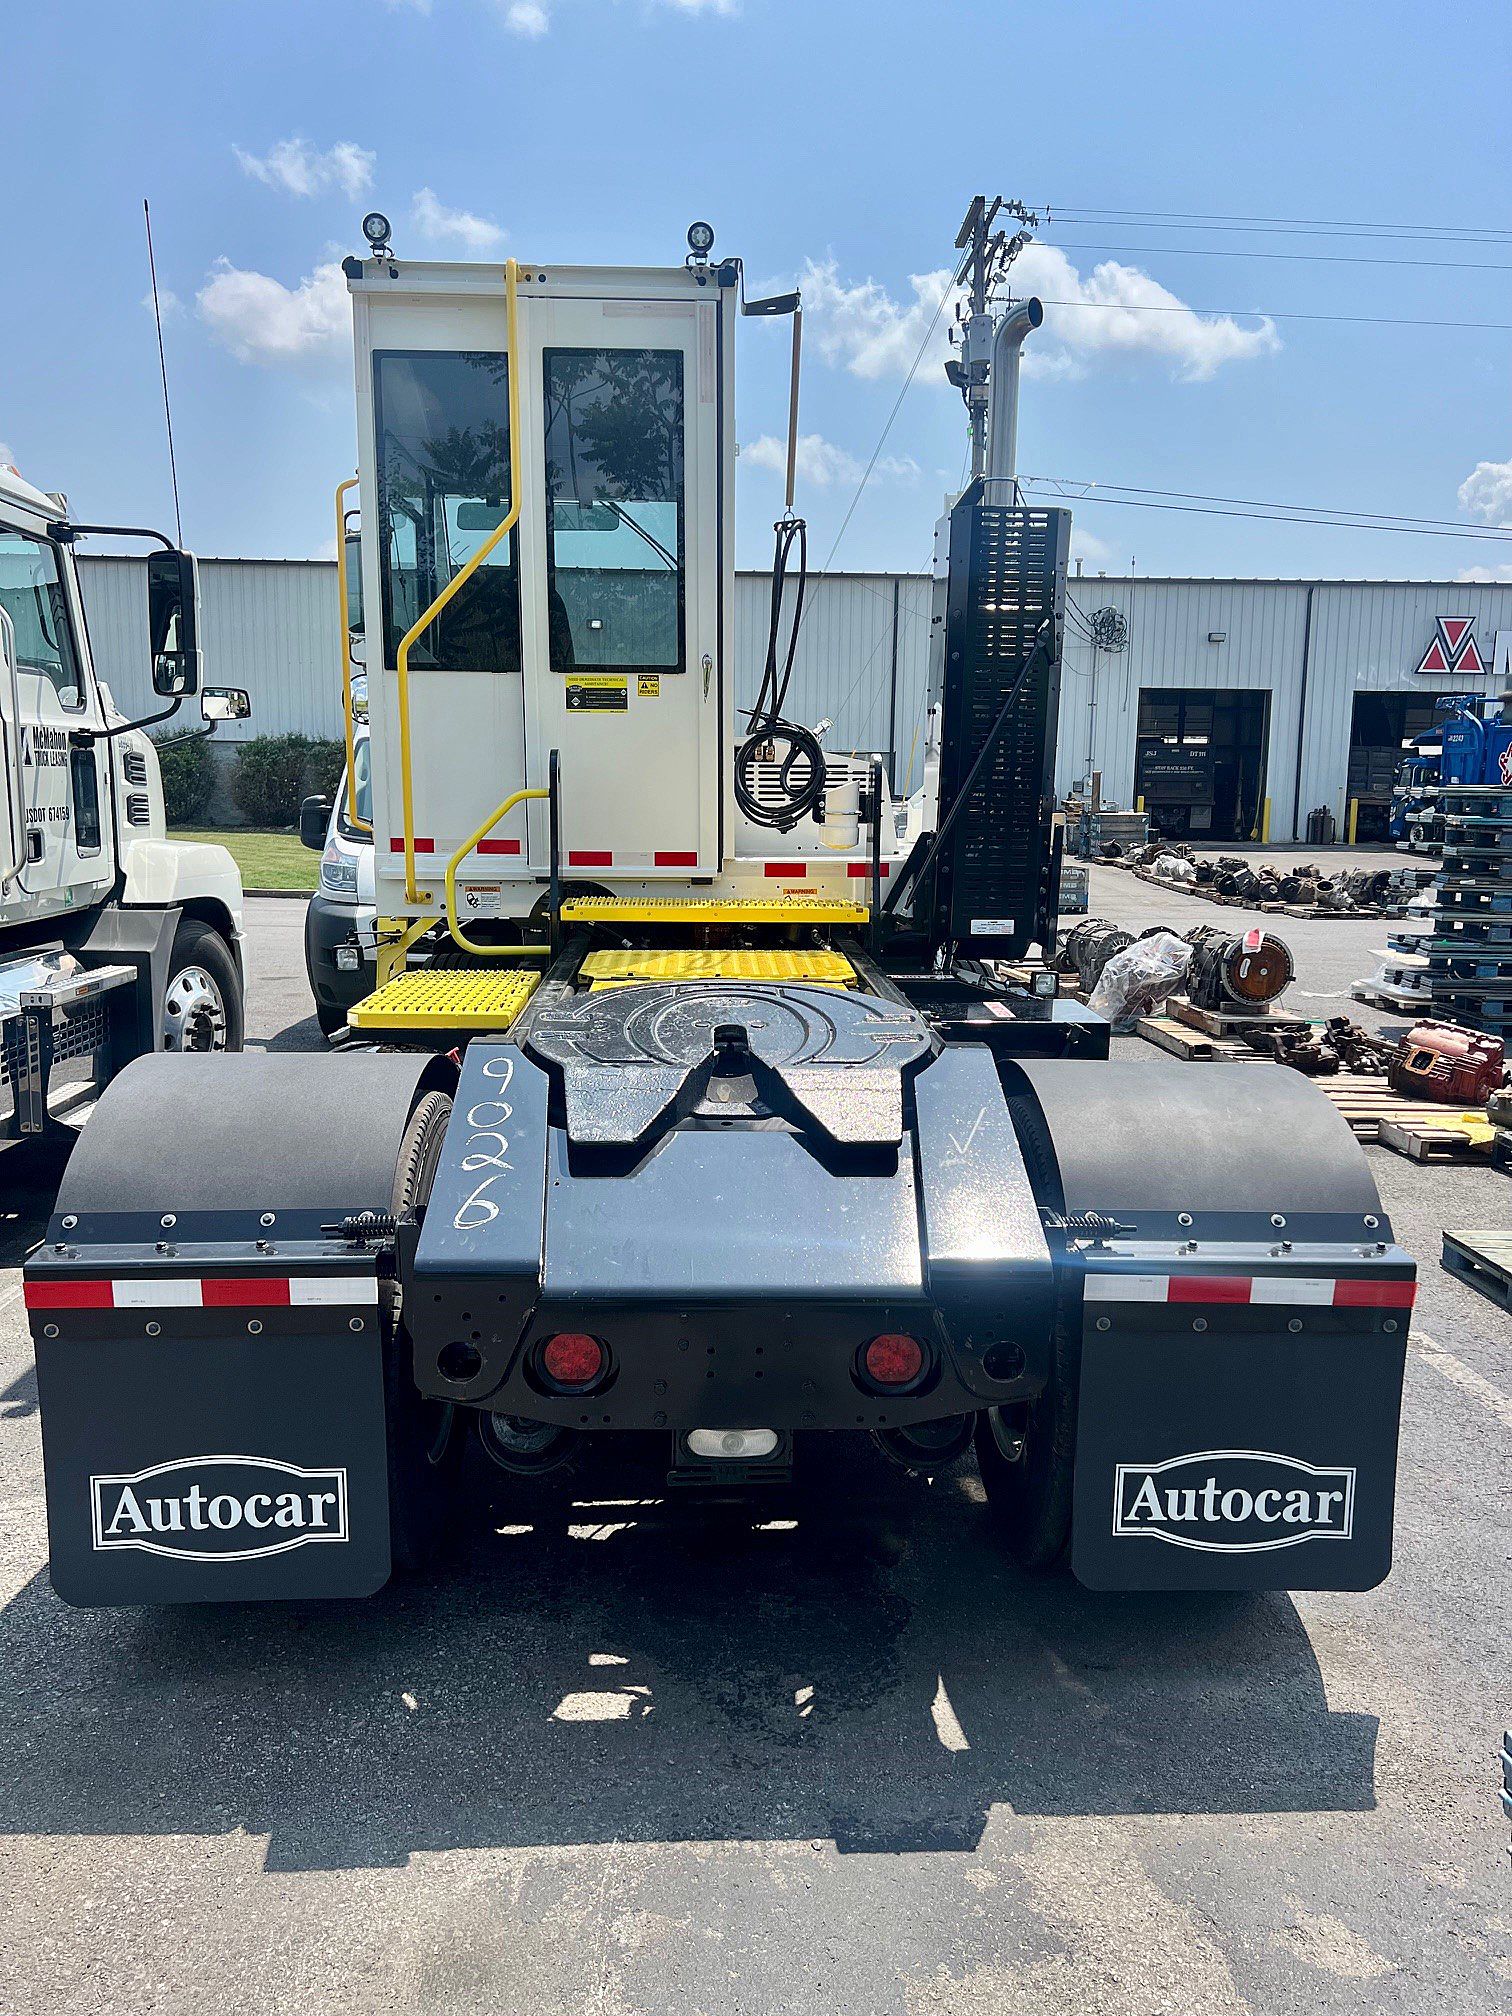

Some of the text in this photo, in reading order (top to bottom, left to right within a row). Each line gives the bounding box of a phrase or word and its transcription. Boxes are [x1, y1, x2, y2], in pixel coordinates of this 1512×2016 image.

[32, 726, 67, 750] McMahon
[34, 750, 68, 768] TRUCK LEASING
[48, 806, 70, 821] 674159
[453, 1057, 515, 1230] 9026
[104, 1484, 336, 1534] Autocar
[1124, 1475, 1343, 1524] Autocar
